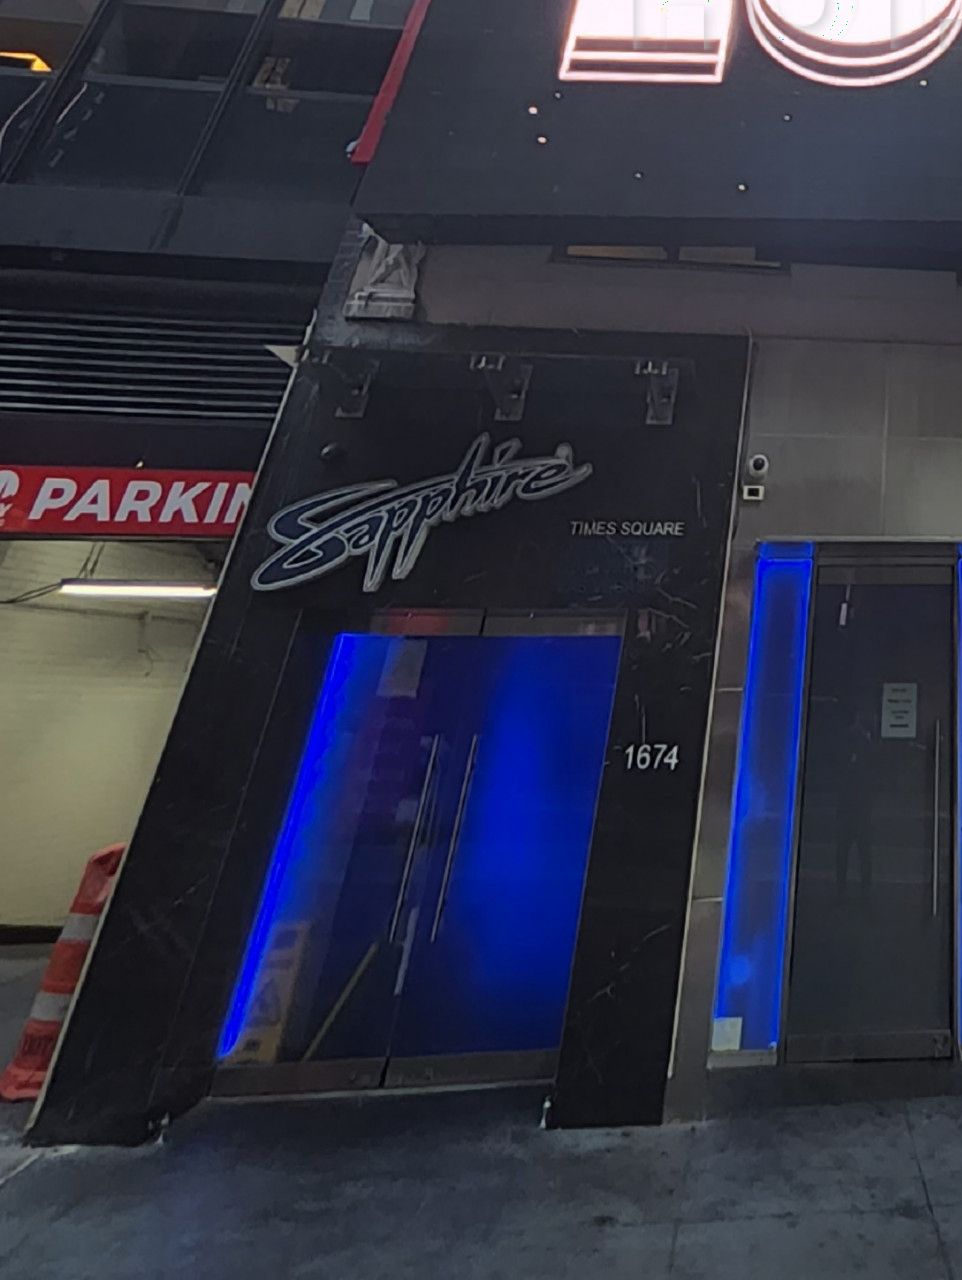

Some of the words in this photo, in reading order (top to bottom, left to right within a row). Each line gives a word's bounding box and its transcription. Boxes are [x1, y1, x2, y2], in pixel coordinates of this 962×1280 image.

[251, 432, 593, 592] Sapphire
[571, 521, 616, 535] TIMES
[620, 521, 685, 536] SQUARE
[625, 744, 679, 770] 1674
